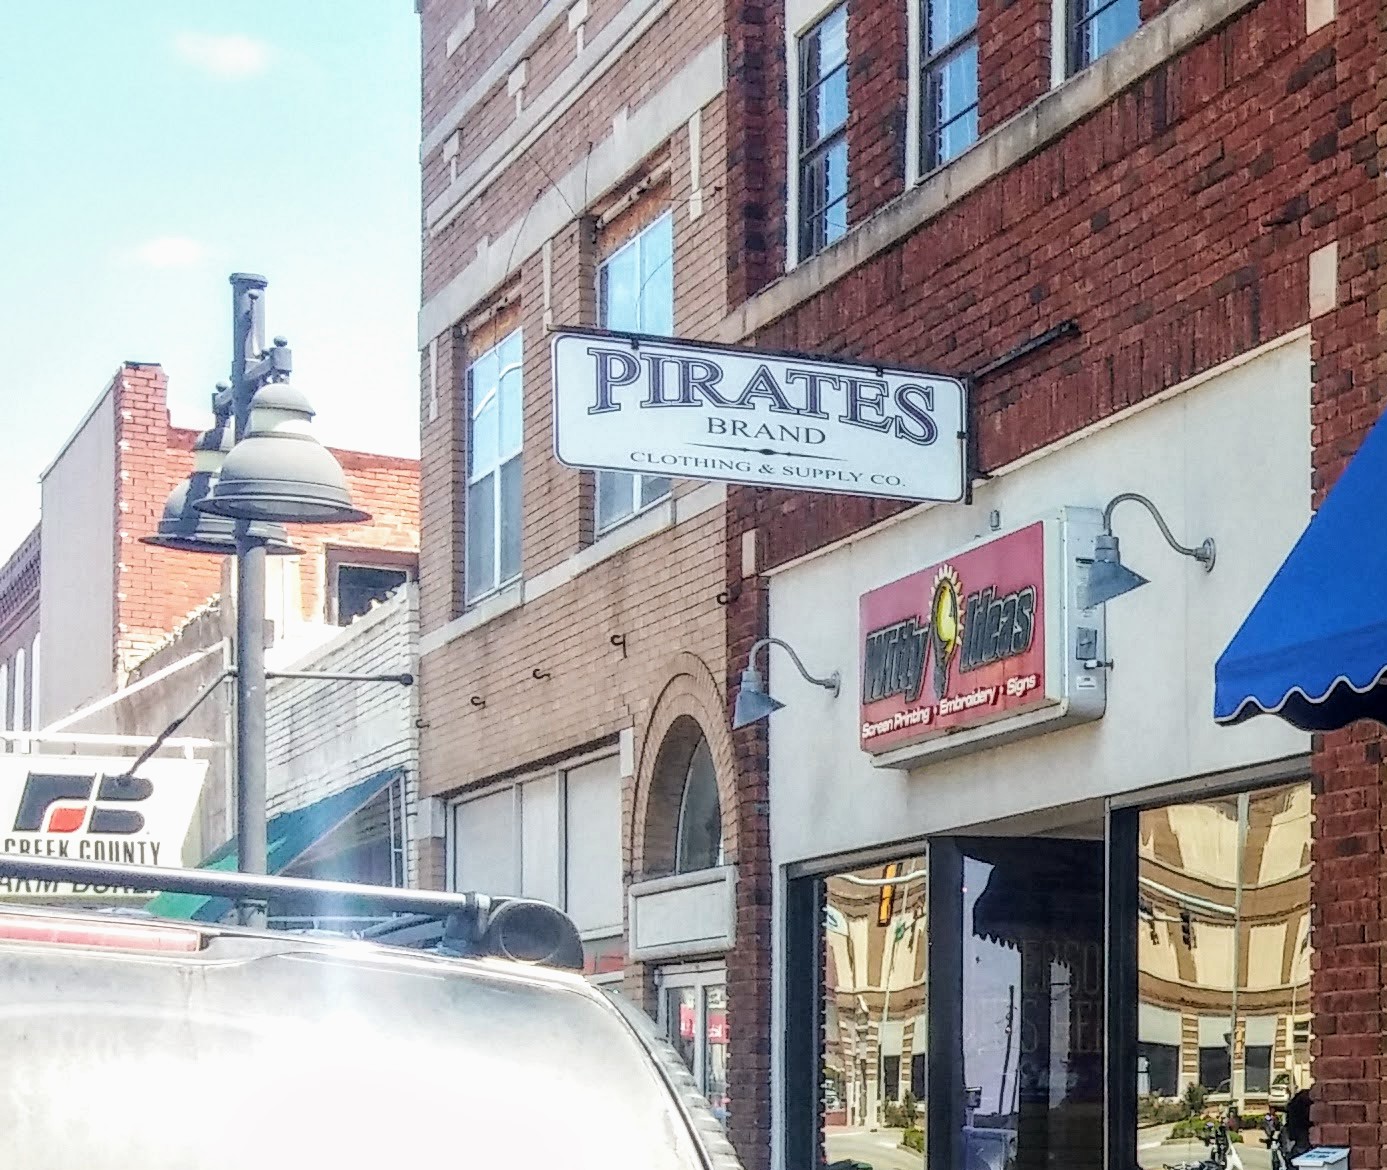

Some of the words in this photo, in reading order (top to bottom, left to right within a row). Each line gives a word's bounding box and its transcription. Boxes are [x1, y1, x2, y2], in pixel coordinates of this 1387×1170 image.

[587, 347, 938, 446] PIRATES
[706, 417, 827, 446] BRAND
[630, 451, 751, 474] CLOTHING
[758, 463, 774, 475] &
[782, 466, 865, 485] SUPPLY
[870, 475, 907, 489] CO.
[959, 585, 1036, 674] Ideas
[862, 718, 893, 739] Screen
[894, 706, 931, 730] Printing
[939, 687, 996, 715] Embroidery
[1006, 674, 1036, 697] Signs
[5, 838, 69, 858] CREEK
[80, 840, 161, 866] COUNTY
